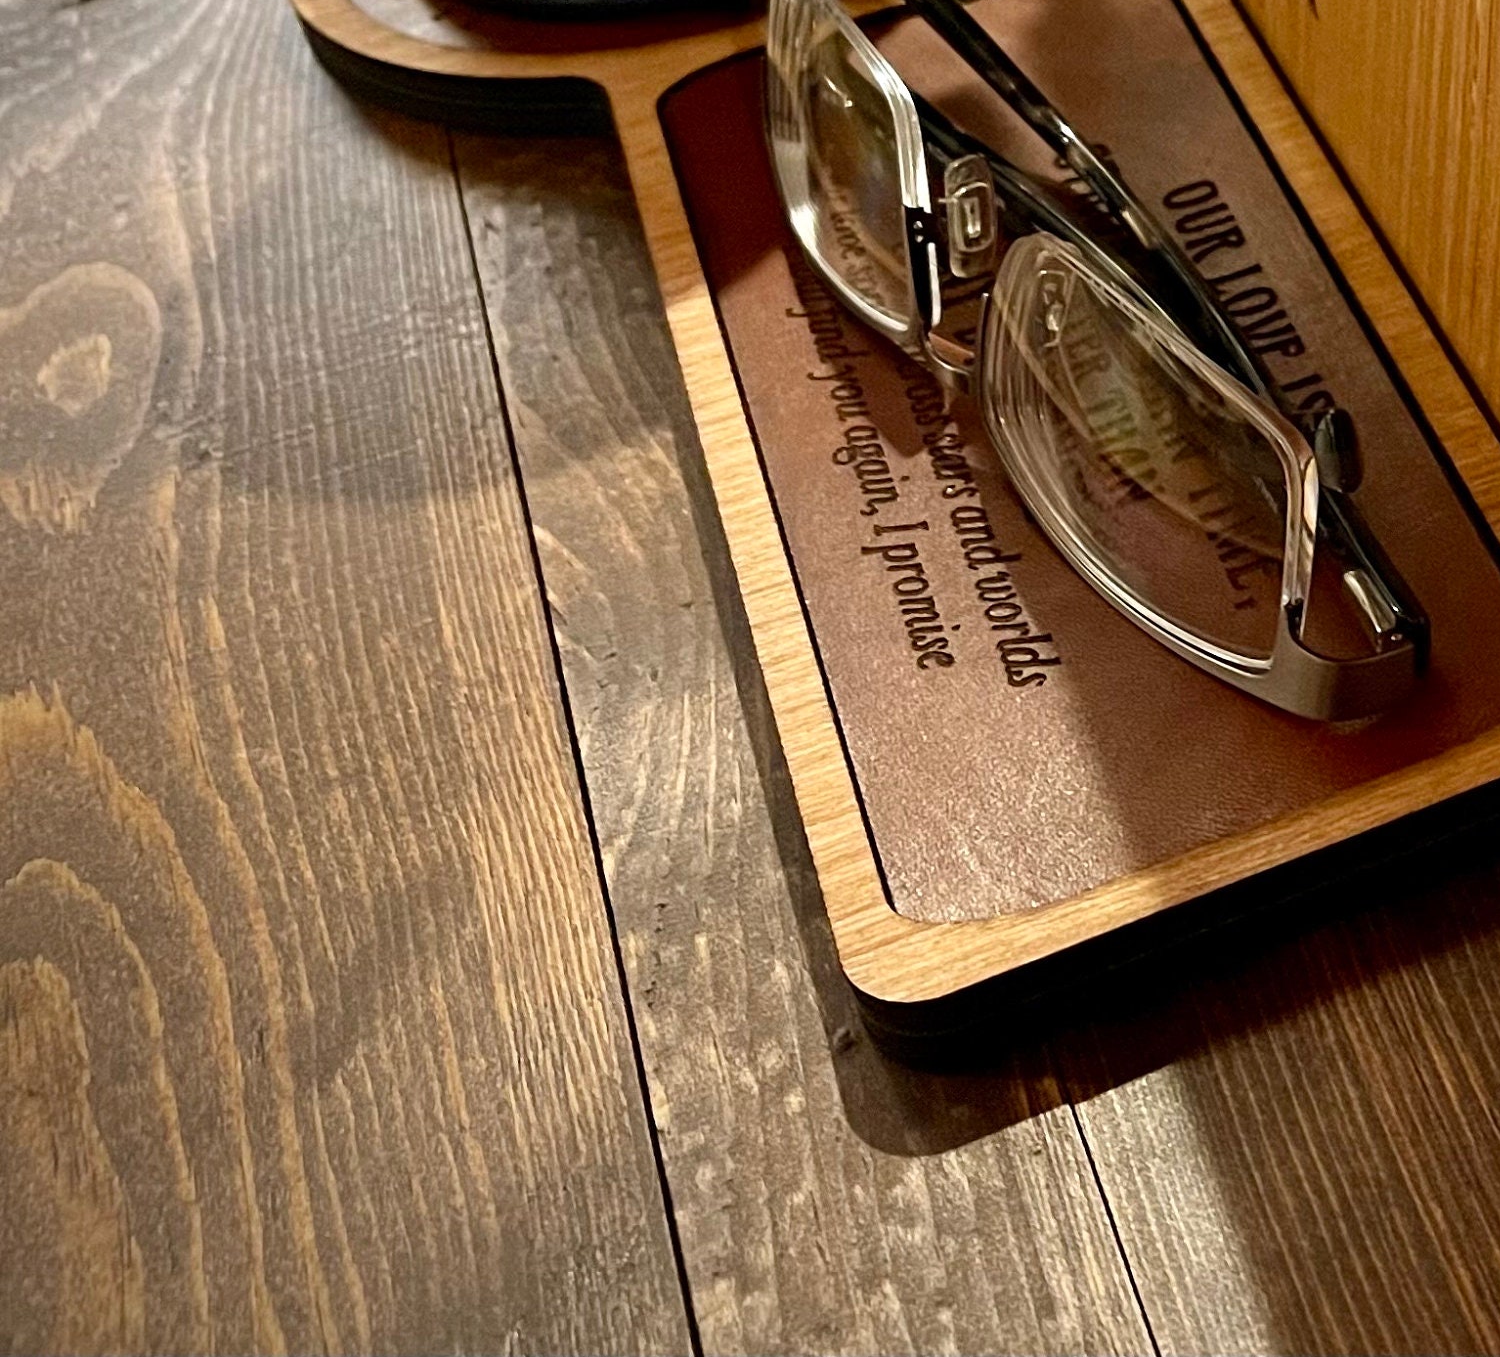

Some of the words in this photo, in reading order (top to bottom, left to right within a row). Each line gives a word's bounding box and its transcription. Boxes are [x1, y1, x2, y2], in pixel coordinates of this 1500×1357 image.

[1162, 179, 1246, 264] OUR
[807, 363, 870, 423] you
[832, 425, 910, 516] again,
[923, 424, 980, 500] stars
[873, 520, 929, 537] I
[951, 505, 1022, 571] and
[861, 543, 960, 671] promise
[975, 570, 1061, 688] worlds
